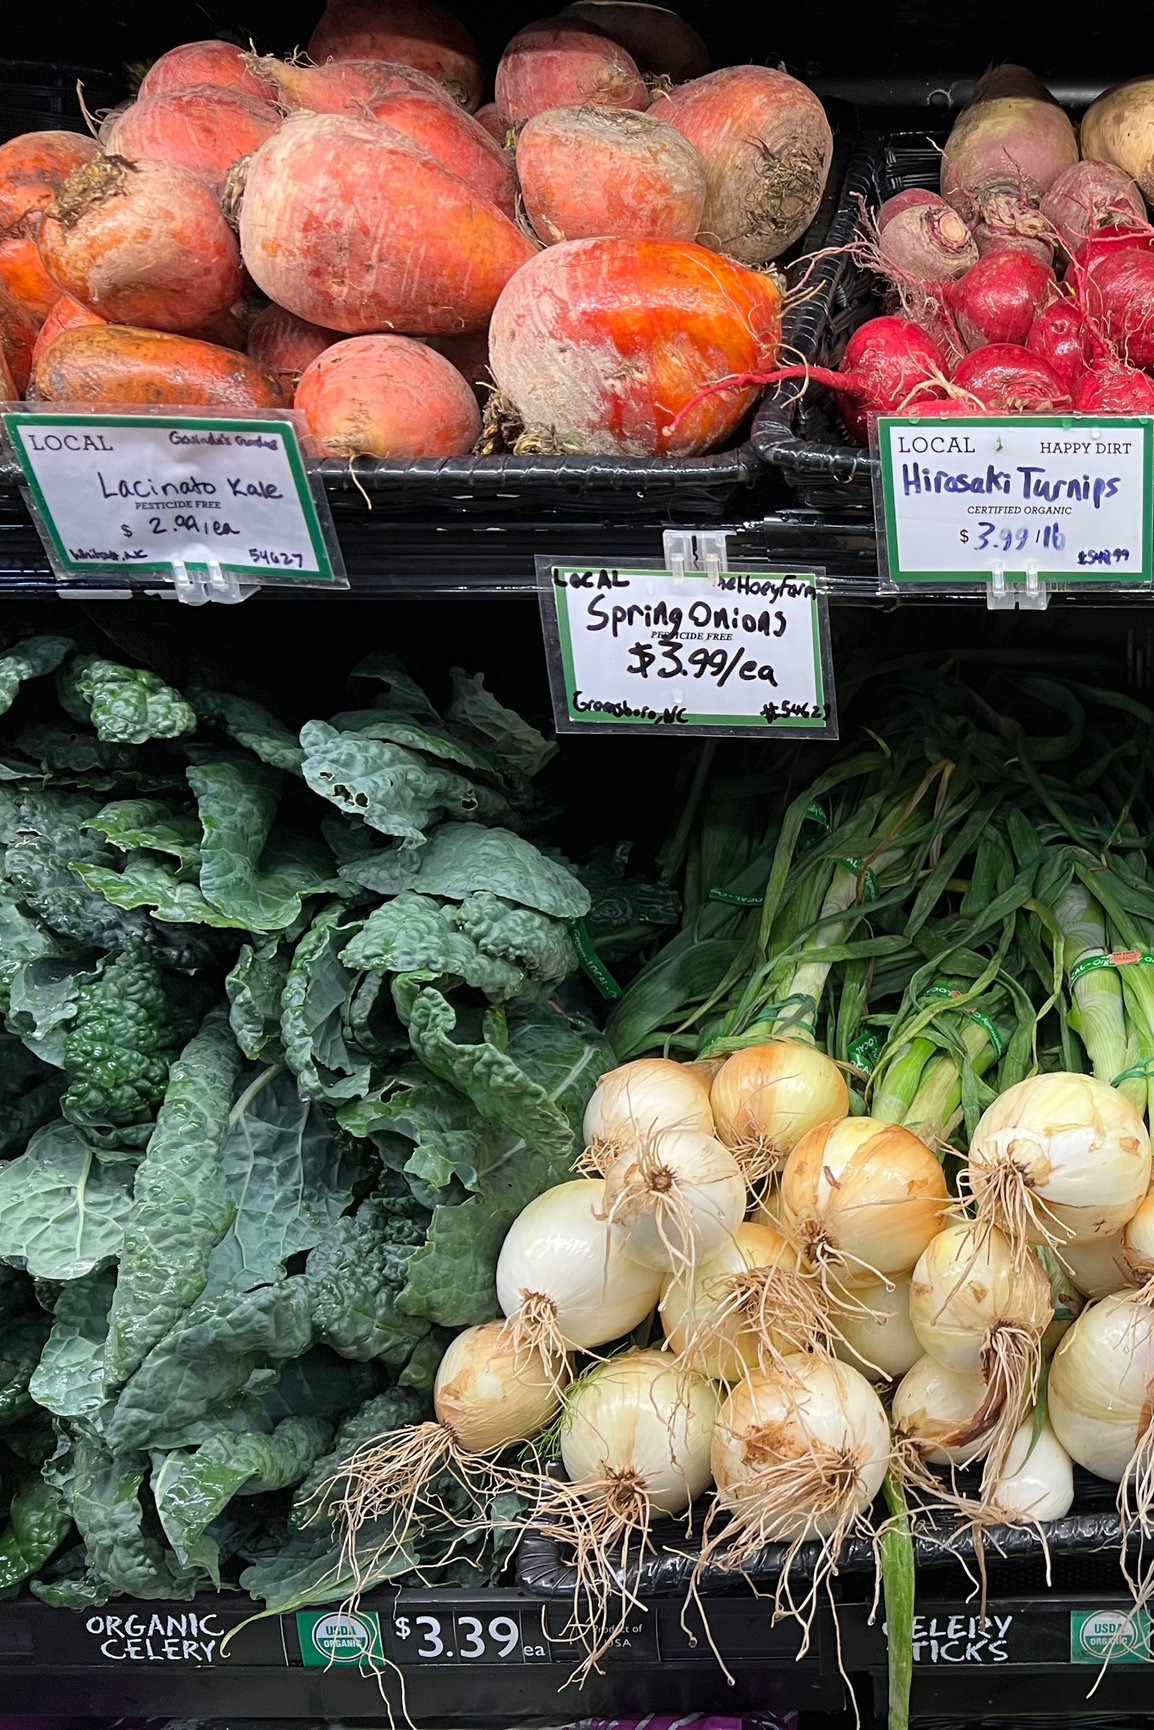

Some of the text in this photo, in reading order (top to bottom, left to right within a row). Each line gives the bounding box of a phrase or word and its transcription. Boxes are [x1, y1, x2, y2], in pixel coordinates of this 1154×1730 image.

[29, 434, 113, 451] LOCAL
[898, 436, 975, 453] LOCAL
[1040, 442, 1131, 454] HAPPY DIRT
[97, 472, 283, 500] Lacinato Kale
[1017, 466, 1121, 509] Turnips
[135, 500, 221, 510] PESTICIDE FREE
[967, 506, 1072, 515] CERTIFIED ORGANIC
[121, 523, 132, 538] $
[959, 529, 969, 544] $
[248, 548, 303, 568] 54627
[586, 594, 787, 640] Spring Onions
[707, 633, 733, 641] FREE
[627, 641, 778, 687] $3.99/ea
[86, 1613, 225, 1638] ORGANIC
[632, 1623, 643, 1633] of
[100, 1638, 216, 1662] CELERY
[523, 1645, 547, 1657] ea
[886, 1639, 1009, 1663] TICKS
